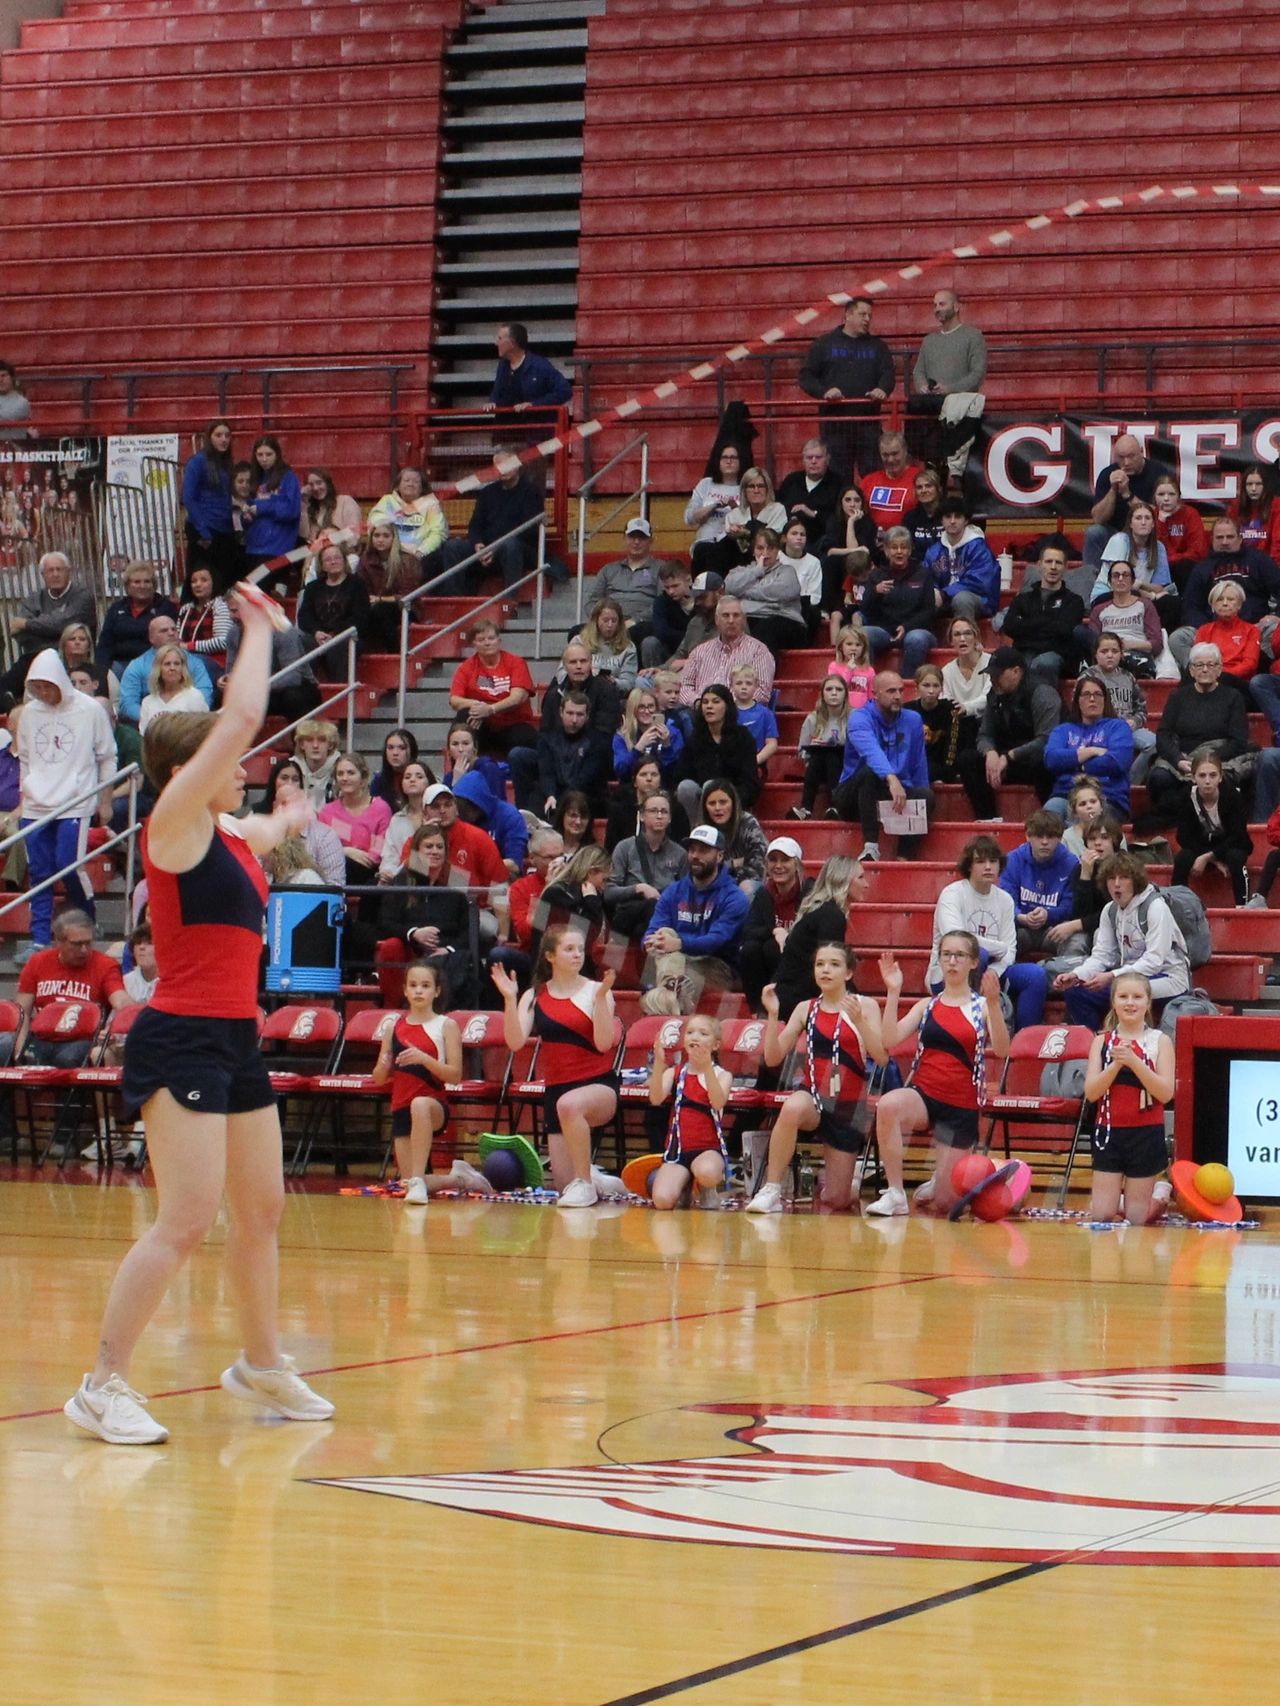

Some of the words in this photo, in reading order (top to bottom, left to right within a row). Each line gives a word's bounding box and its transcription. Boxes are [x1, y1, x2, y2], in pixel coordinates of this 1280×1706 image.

[15, 450, 84, 463] BASKETBALL
[1102, 614, 1143, 626] WARRIORS
[273, 897, 283, 965] POWERADE
[36, 980, 91, 1000] RONCALLI
